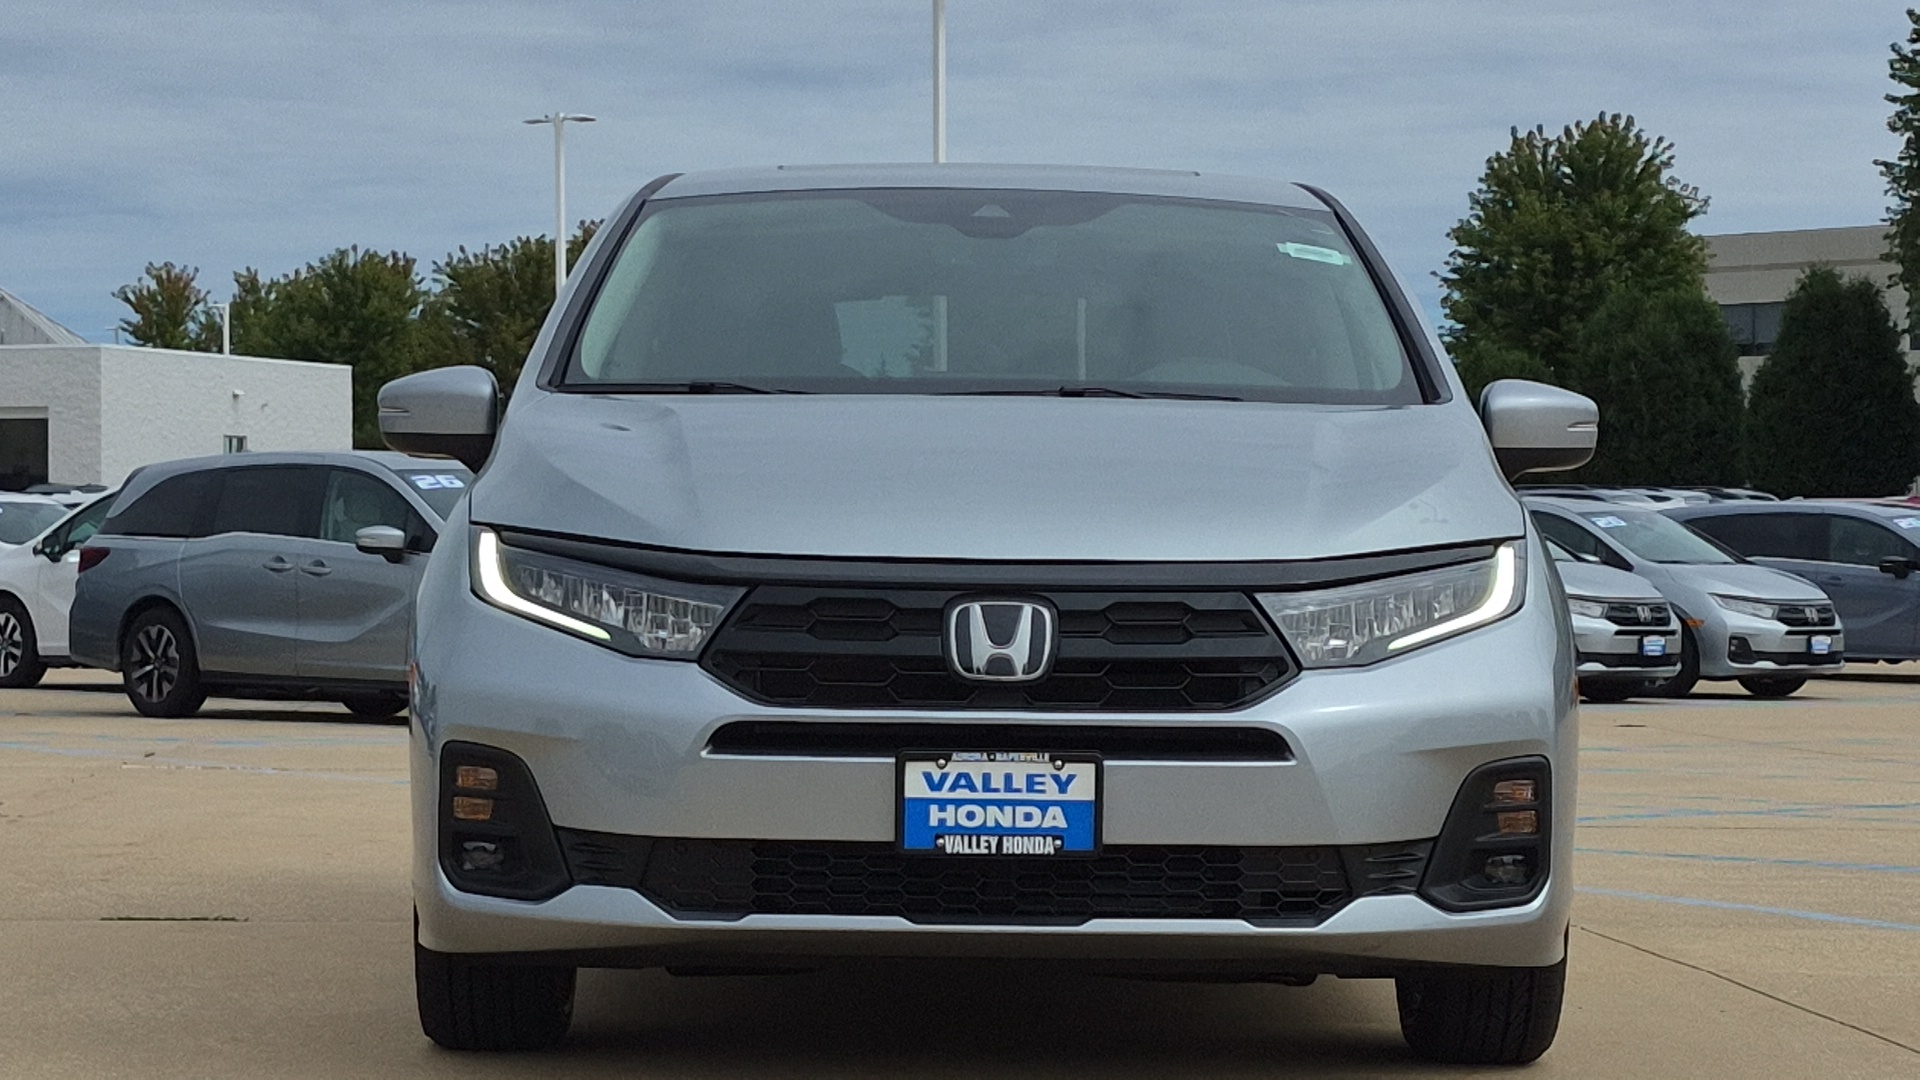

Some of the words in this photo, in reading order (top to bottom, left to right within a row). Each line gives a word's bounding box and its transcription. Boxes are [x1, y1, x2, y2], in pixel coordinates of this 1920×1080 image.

[411, 474, 465, 489] 26
[922, 771, 1078, 794] VALLEY
[928, 804, 1068, 828] HONDA
[944, 835, 1000, 854] VALLEY
[1002, 836, 1055, 855] HONDA
